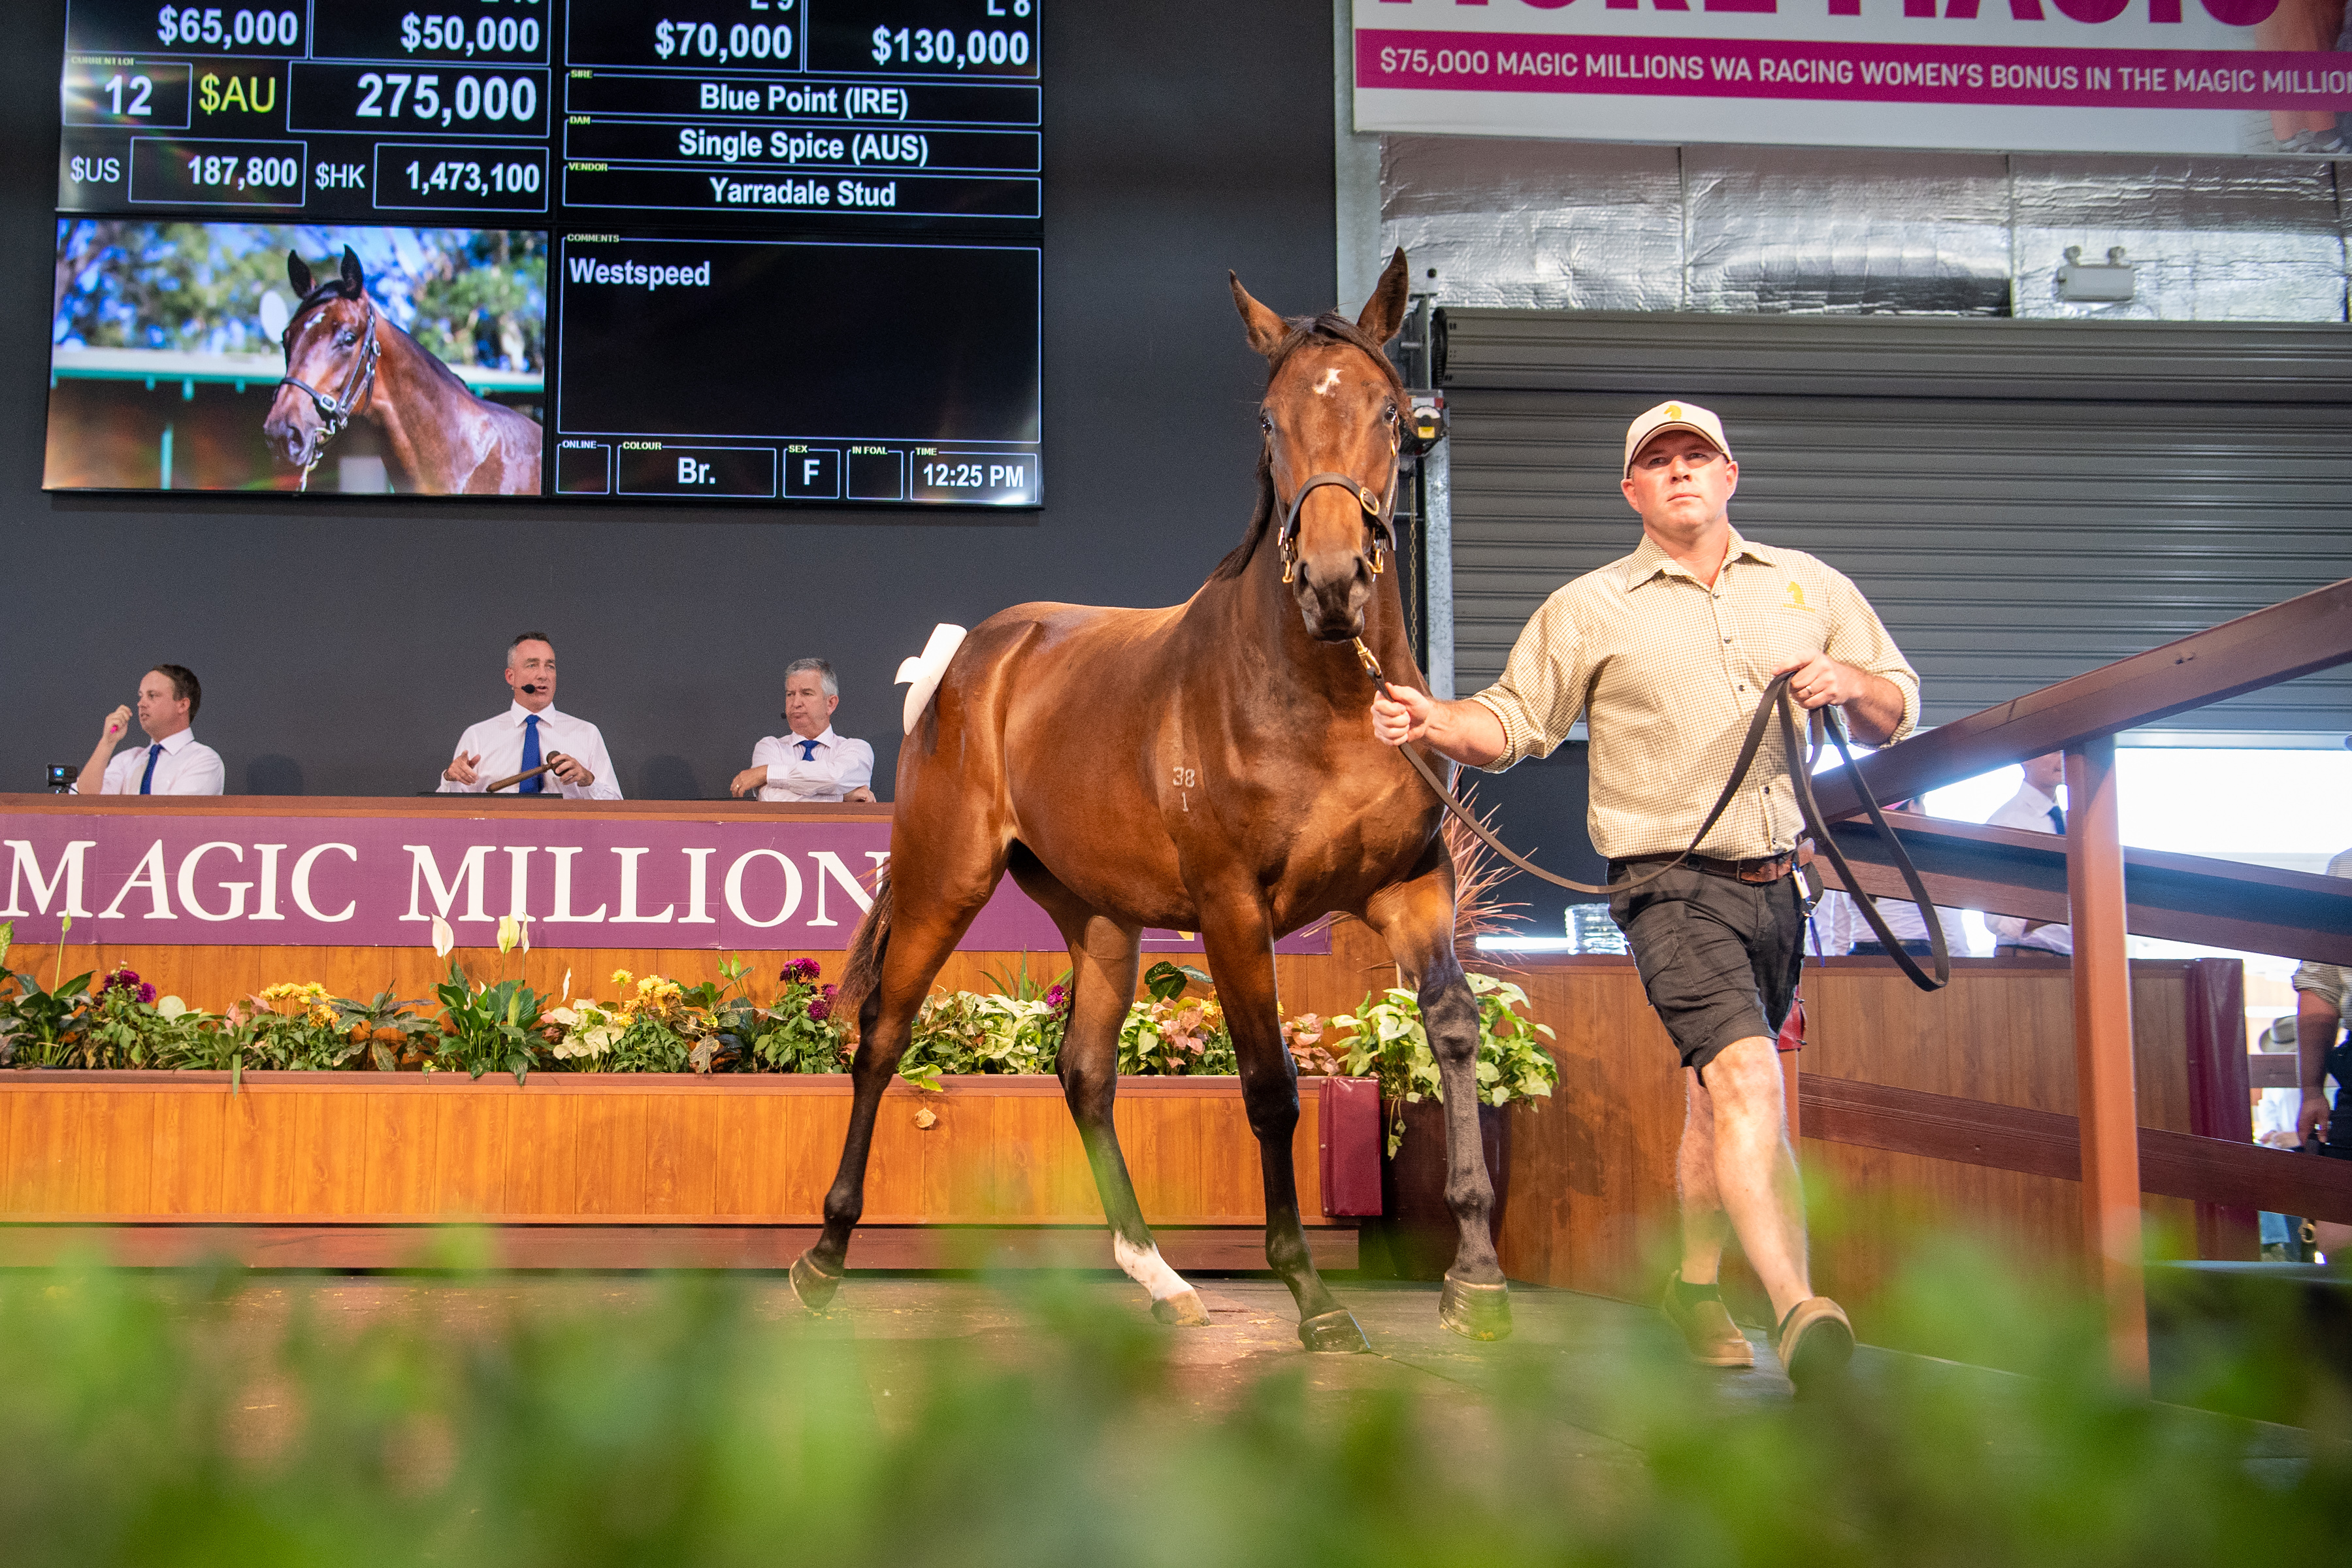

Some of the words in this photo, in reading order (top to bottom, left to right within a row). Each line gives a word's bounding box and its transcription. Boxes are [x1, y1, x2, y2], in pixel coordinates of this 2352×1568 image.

[156, 4, 299, 50] $65,000
[400, 10, 540, 57] $50,000
[654, 18, 793, 64] $70,000
[872, 24, 1030, 70] $130,000
[570, 69, 593, 79] SIRE
[1380, 46, 1489, 76] $75,000
[1497, 51, 1578, 77] MAGIC
[1585, 54, 1705, 80] MILLIONS
[1710, 56, 1753, 82] WA
[1759, 57, 1854, 84] RACING
[1990, 64, 2079, 90] BONUS
[2085, 67, 2112, 91] IN
[2117, 67, 2168, 91] THE
[2174, 68, 2256, 93] MAGIC
[104, 74, 153, 116] 12
[199, 72, 276, 116] $AU
[355, 72, 537, 127] 275,000
[700, 83, 760, 111] Blue
[768, 84, 838, 114] Point
[844, 87, 909, 120] (IRE)
[569, 116, 591, 125] DAM
[678, 127, 763, 163] Single
[768, 130, 844, 165] Spice
[851, 134, 928, 167] (AUS)
[70, 155, 120, 184] $US
[188, 155, 297, 191] 187,800
[314, 161, 366, 190] $HK
[406, 160, 540, 197] 1,473,100
[568, 161, 610, 172] VENDOR
[710, 176, 830, 205] Yarradale
[837, 179, 896, 207] Stud
[566, 233, 620, 243] COMMENTS
[568, 257, 710, 291] Westspeed
[561, 440, 597, 449] ONLINE
[622, 441, 662, 451] COLOUR
[788, 444, 808, 453] SEX
[852, 446, 862, 455] IN
[863, 446, 888, 455] FOAL
[915, 447, 938, 456] TIME
[678, 457, 716, 484] Br.
[804, 459, 821, 485] F
[923, 463, 983, 487] 12:25
[990, 465, 1024, 487] PM
[1171, 764, 1196, 788] 38
[0, 839, 357, 925] MAGIC
